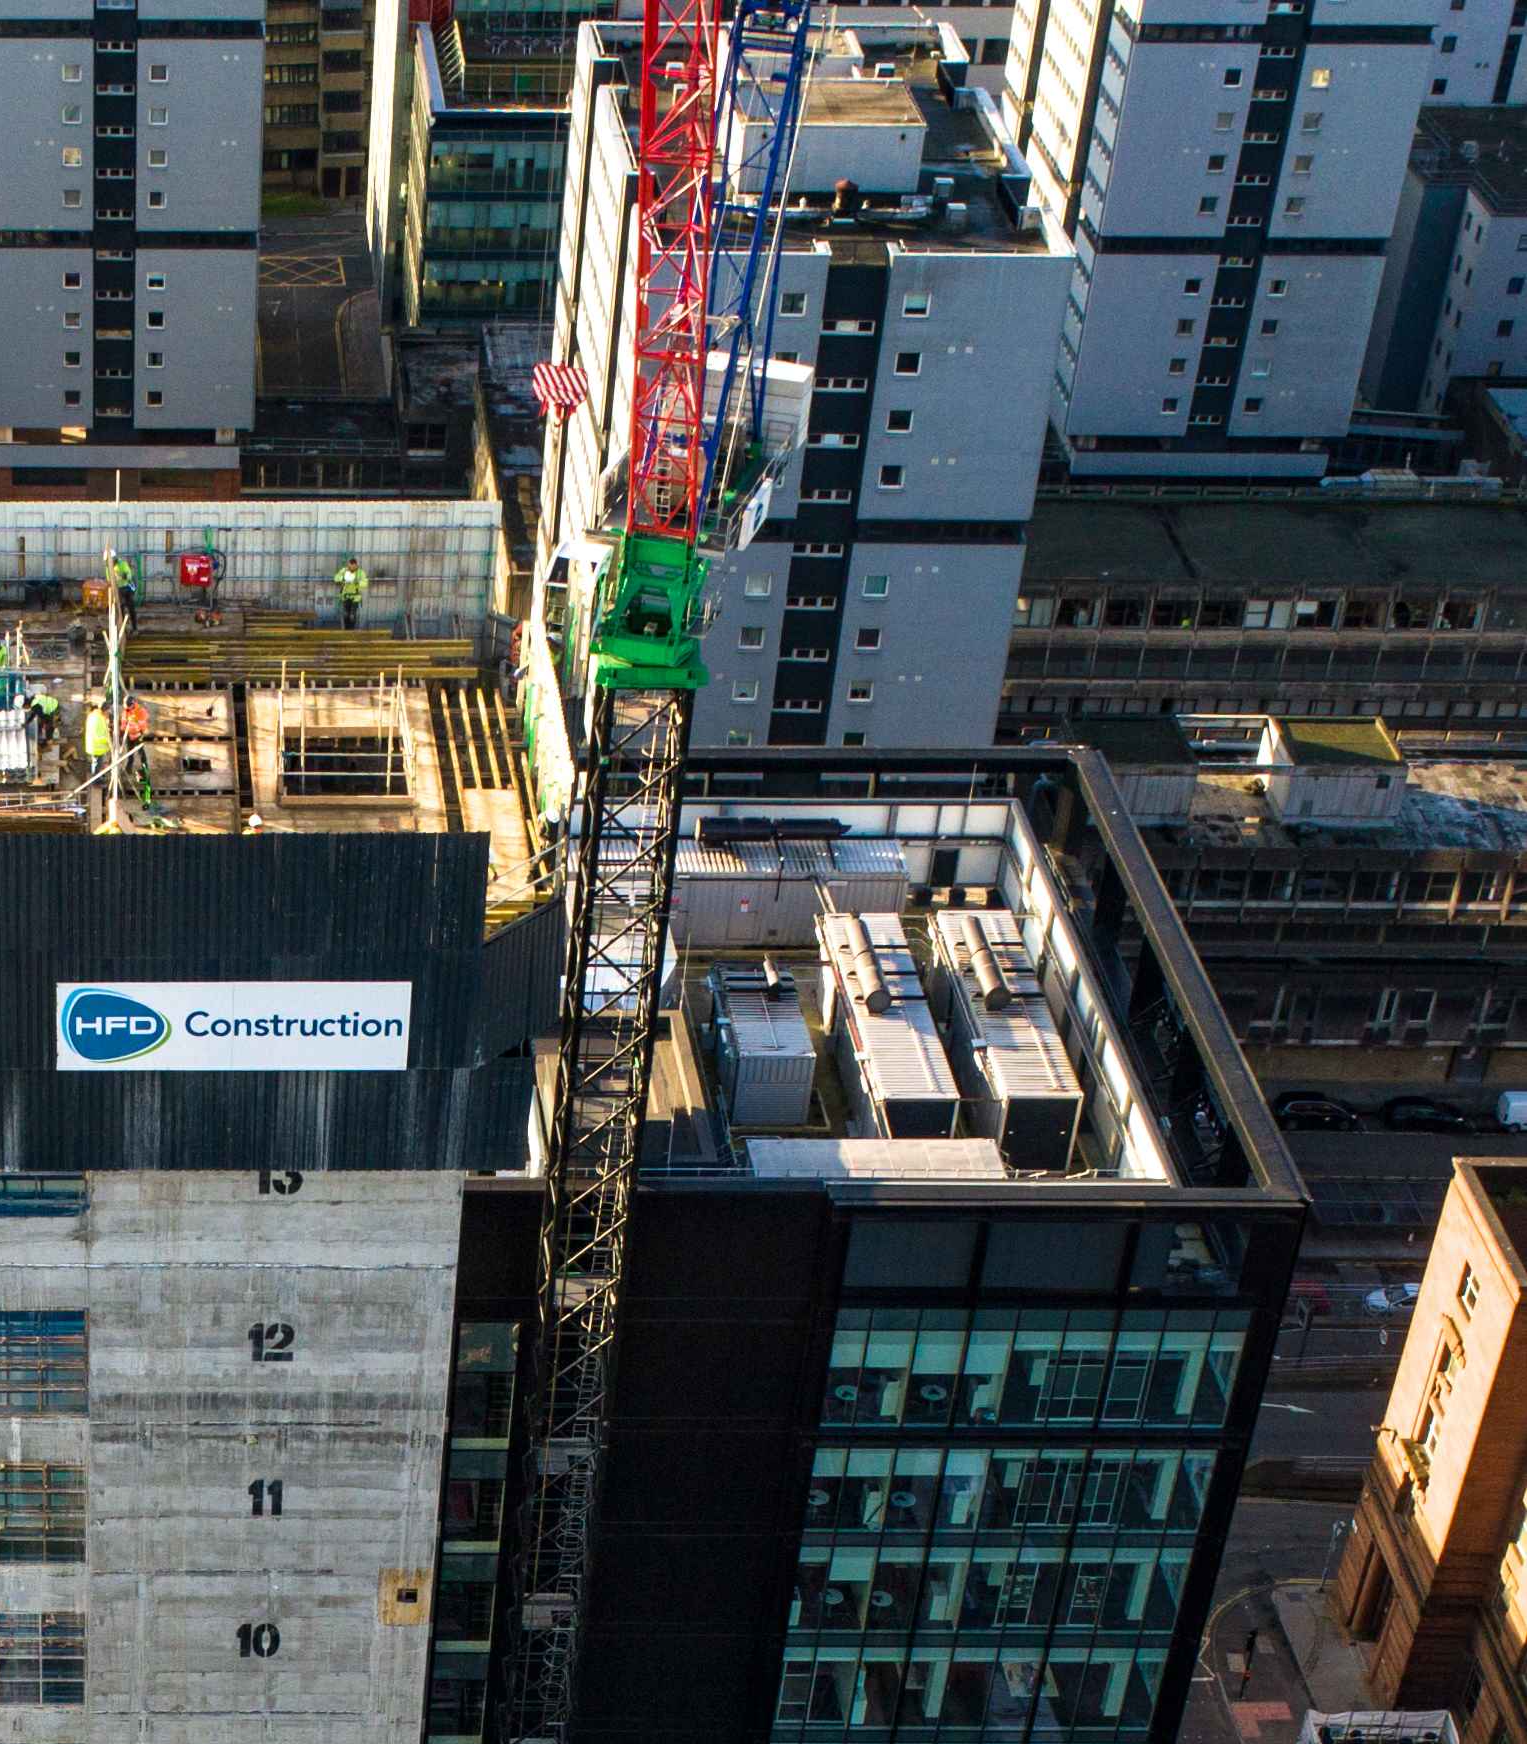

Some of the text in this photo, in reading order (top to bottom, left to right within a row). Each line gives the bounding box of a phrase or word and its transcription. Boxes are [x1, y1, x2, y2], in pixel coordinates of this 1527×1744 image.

[75, 1010, 403, 1037] HFD Construction
[247, 1322, 295, 1362] 12
[248, 1478, 283, 1517] 11
[236, 1622, 281, 1658] 10
